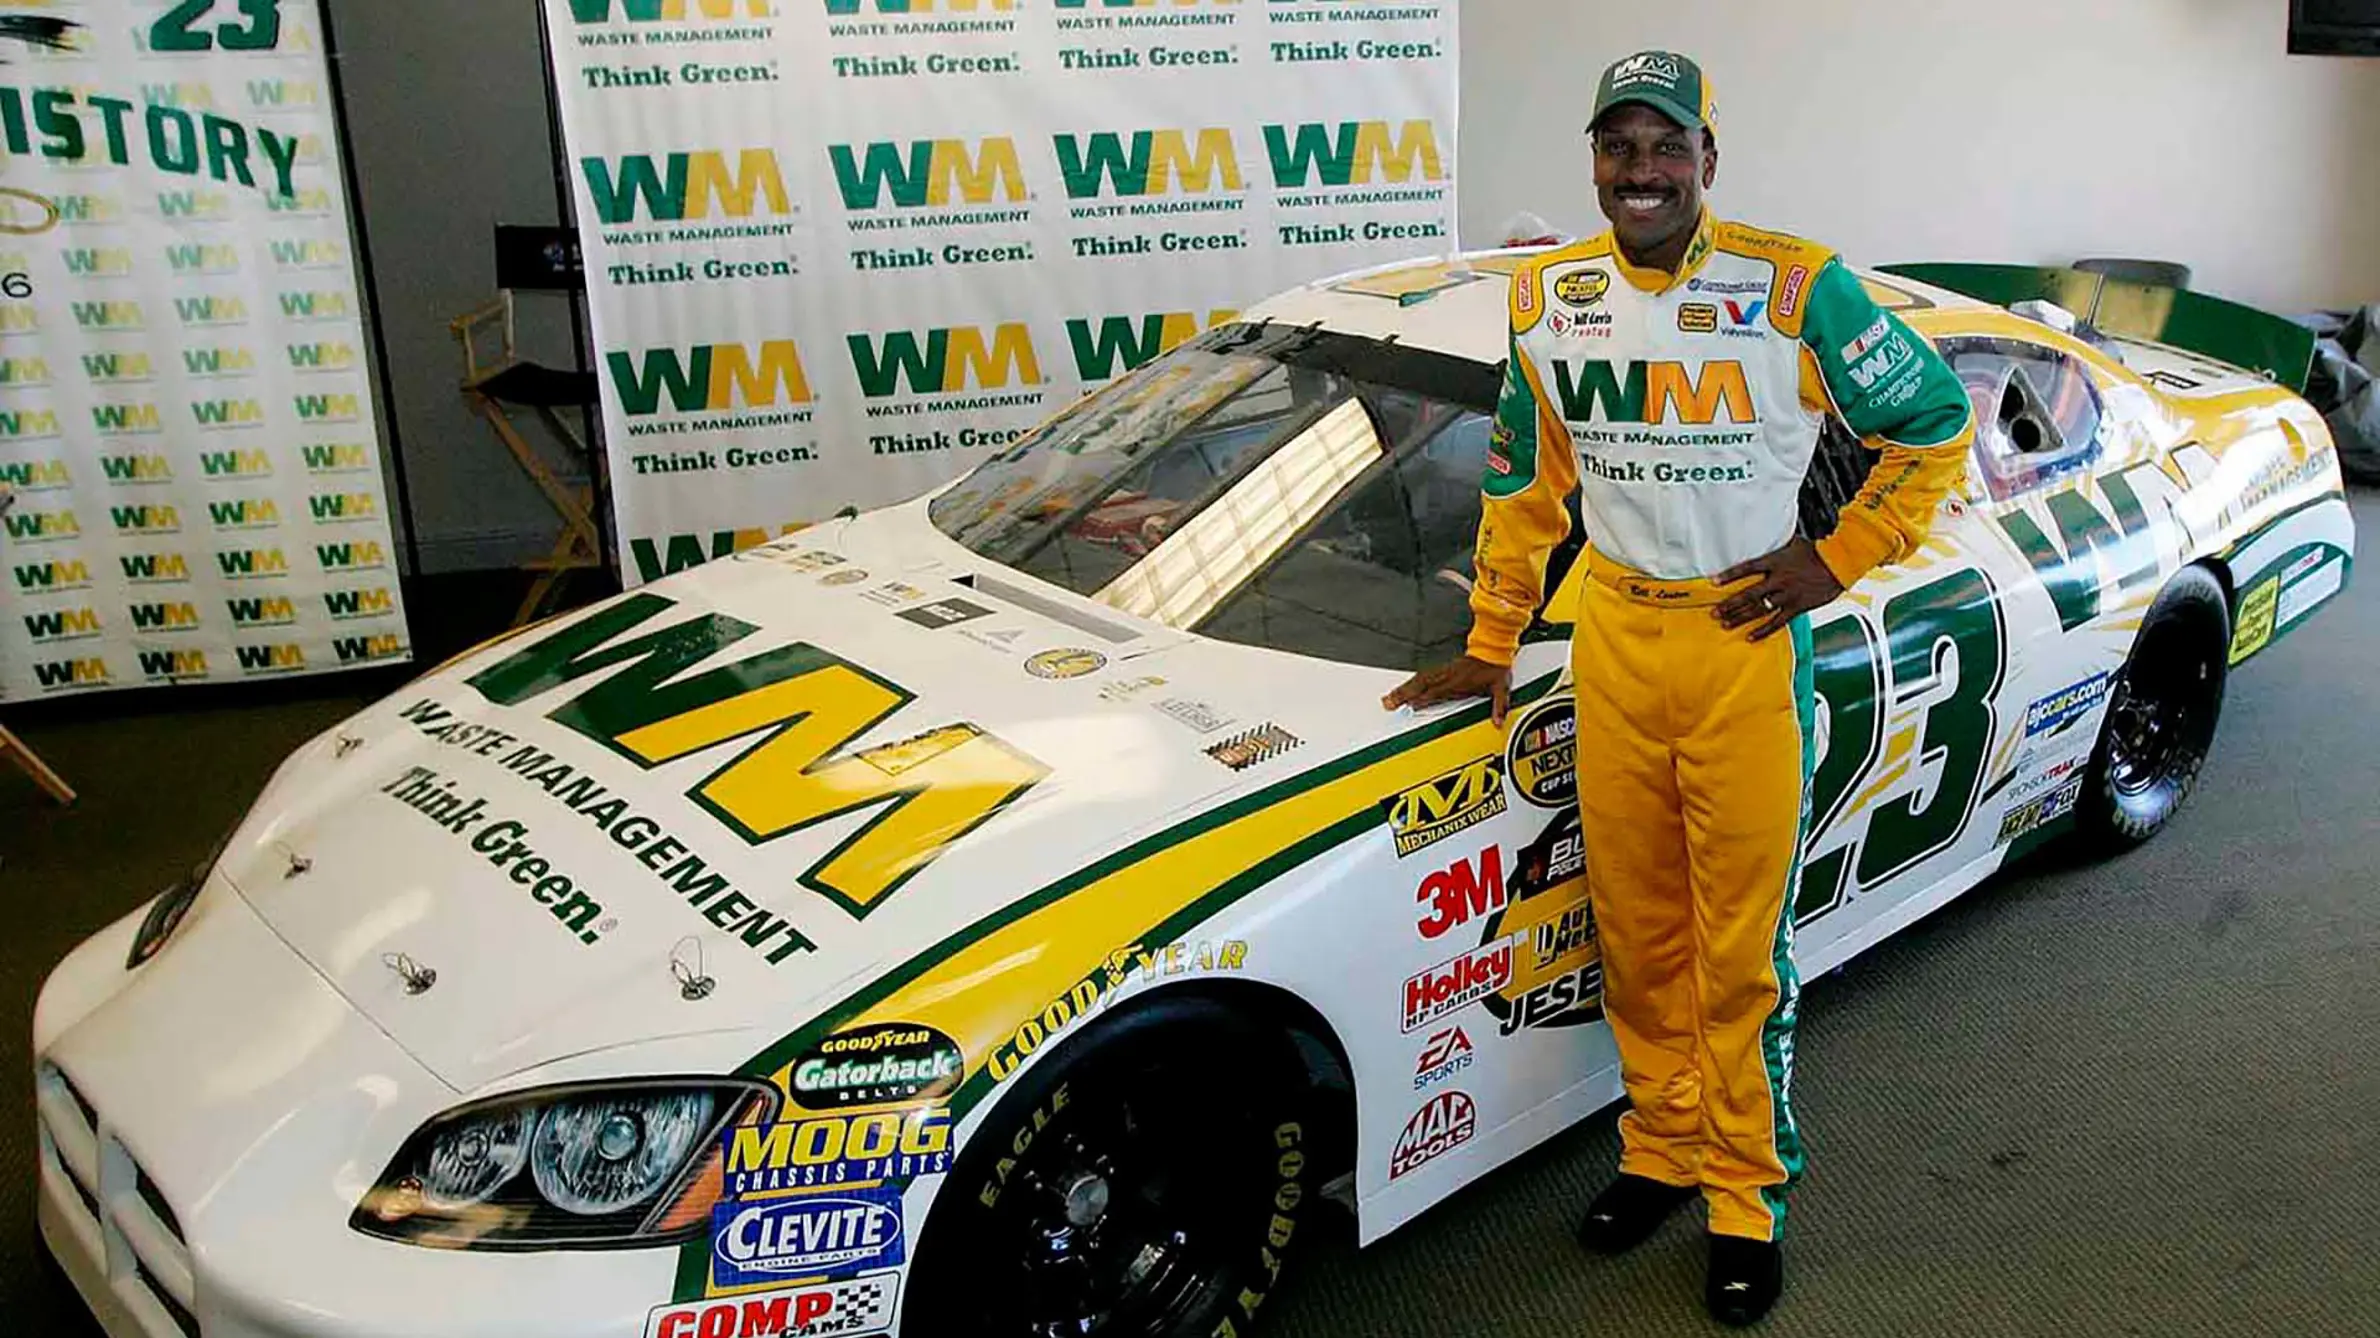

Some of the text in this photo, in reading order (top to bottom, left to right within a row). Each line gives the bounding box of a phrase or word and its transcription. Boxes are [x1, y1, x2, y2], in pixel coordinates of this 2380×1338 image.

[829, 20, 1016, 37] WASTE MANAGEMENT
[1057, 13, 1235, 30] WASTE MANAGEMENT
[1269, 8, 1439, 23] WASTE MANAGEMENT
[578, 28, 773, 46] WASTE MANAGEMENT
[1060, 48, 1139, 69] Think
[1271, 41, 1348, 62] Think
[582, 65, 671, 88] Think
[833, 54, 917, 77] Think
[1053, 128, 1243, 198] WM
[1262, 119, 1443, 188] WM
[580, 148, 791, 225] WM
[827, 137, 1027, 210] WM
[1070, 199, 1244, 219] WASTE MANAGEMENT
[1276, 189, 1443, 208] WASTE MANAGEMENT
[602, 223, 794, 246] WASTE MANAGEMENT
[847, 210, 1030, 232] WASTE MANAGEMENT
[1279, 224, 1355, 245] Think
[851, 249, 933, 271] Think
[1073, 236, 1151, 258] Think
[2, 273, 32, 298] 6
[608, 264, 693, 286] Think
[846, 322, 1042, 397] WM
[605, 338, 815, 415] WM
[866, 393, 1045, 417] WASTE MANAGEMENT
[1551, 360, 1756, 424] WM
[92, 404, 160, 428] WM
[191, 400, 262, 424] WM
[294, 395, 358, 417] WM
[628, 412, 813, 436] WASTE MANAGEMENT
[870, 427, 1033, 454] Think Gree
[1625, 432, 1753, 446] MANAGEMENT
[102, 454, 171, 479] WM
[200, 448, 272, 476] WM
[302, 444, 366, 468] WM
[633, 451, 717, 474] Think
[1583, 453, 1644, 481] Think
[110, 504, 180, 530] WM
[208, 498, 280, 526] WM
[309, 492, 374, 517] WM
[4, 511, 79, 538] WM
[120, 553, 191, 580] WM
[217, 548, 289, 575] WM
[316, 541, 384, 568] WM
[631, 522, 816, 584] W
[14, 560, 90, 588] WM
[130, 602, 198, 626] WM
[227, 596, 296, 623] WM
[324, 587, 392, 614] WM
[24, 608, 102, 639] WM
[236, 643, 304, 670] WM
[333, 633, 398, 660] WM
[34, 658, 108, 687] WM
[139, 649, 208, 674] WM
[466, 592, 1048, 919] WM
[400, 698, 817, 966] WASTE MANAGEMENT
[1398, 793, 1506, 853] MECHANIX WEAR
[380, 766, 604, 945] Think Green.
[1417, 843, 1505, 939] 3M
[1406, 945, 1510, 1016] Holley
[987, 940, 1249, 1082] GOODYEAR
[821, 1030, 930, 1053] GOODYEAR
[1416, 1025, 1473, 1075] EA
[795, 1050, 958, 1091] Gatorback
[1414, 1053, 1473, 1090] SPORTS
[840, 1086, 916, 1101] BELTS
[726, 1108, 951, 1174] MOOG
[1397, 1096, 1475, 1159] MAC
[979, 1081, 1071, 1208] EAGLE
[1393, 1124, 1473, 1174] TOOLS
[735, 1154, 945, 1193] CHASSIS PARTS
[728, 1205, 885, 1260] CLEVITE
[658, 1292, 834, 1338] COMP
[780, 1314, 865, 1338] CAMS
